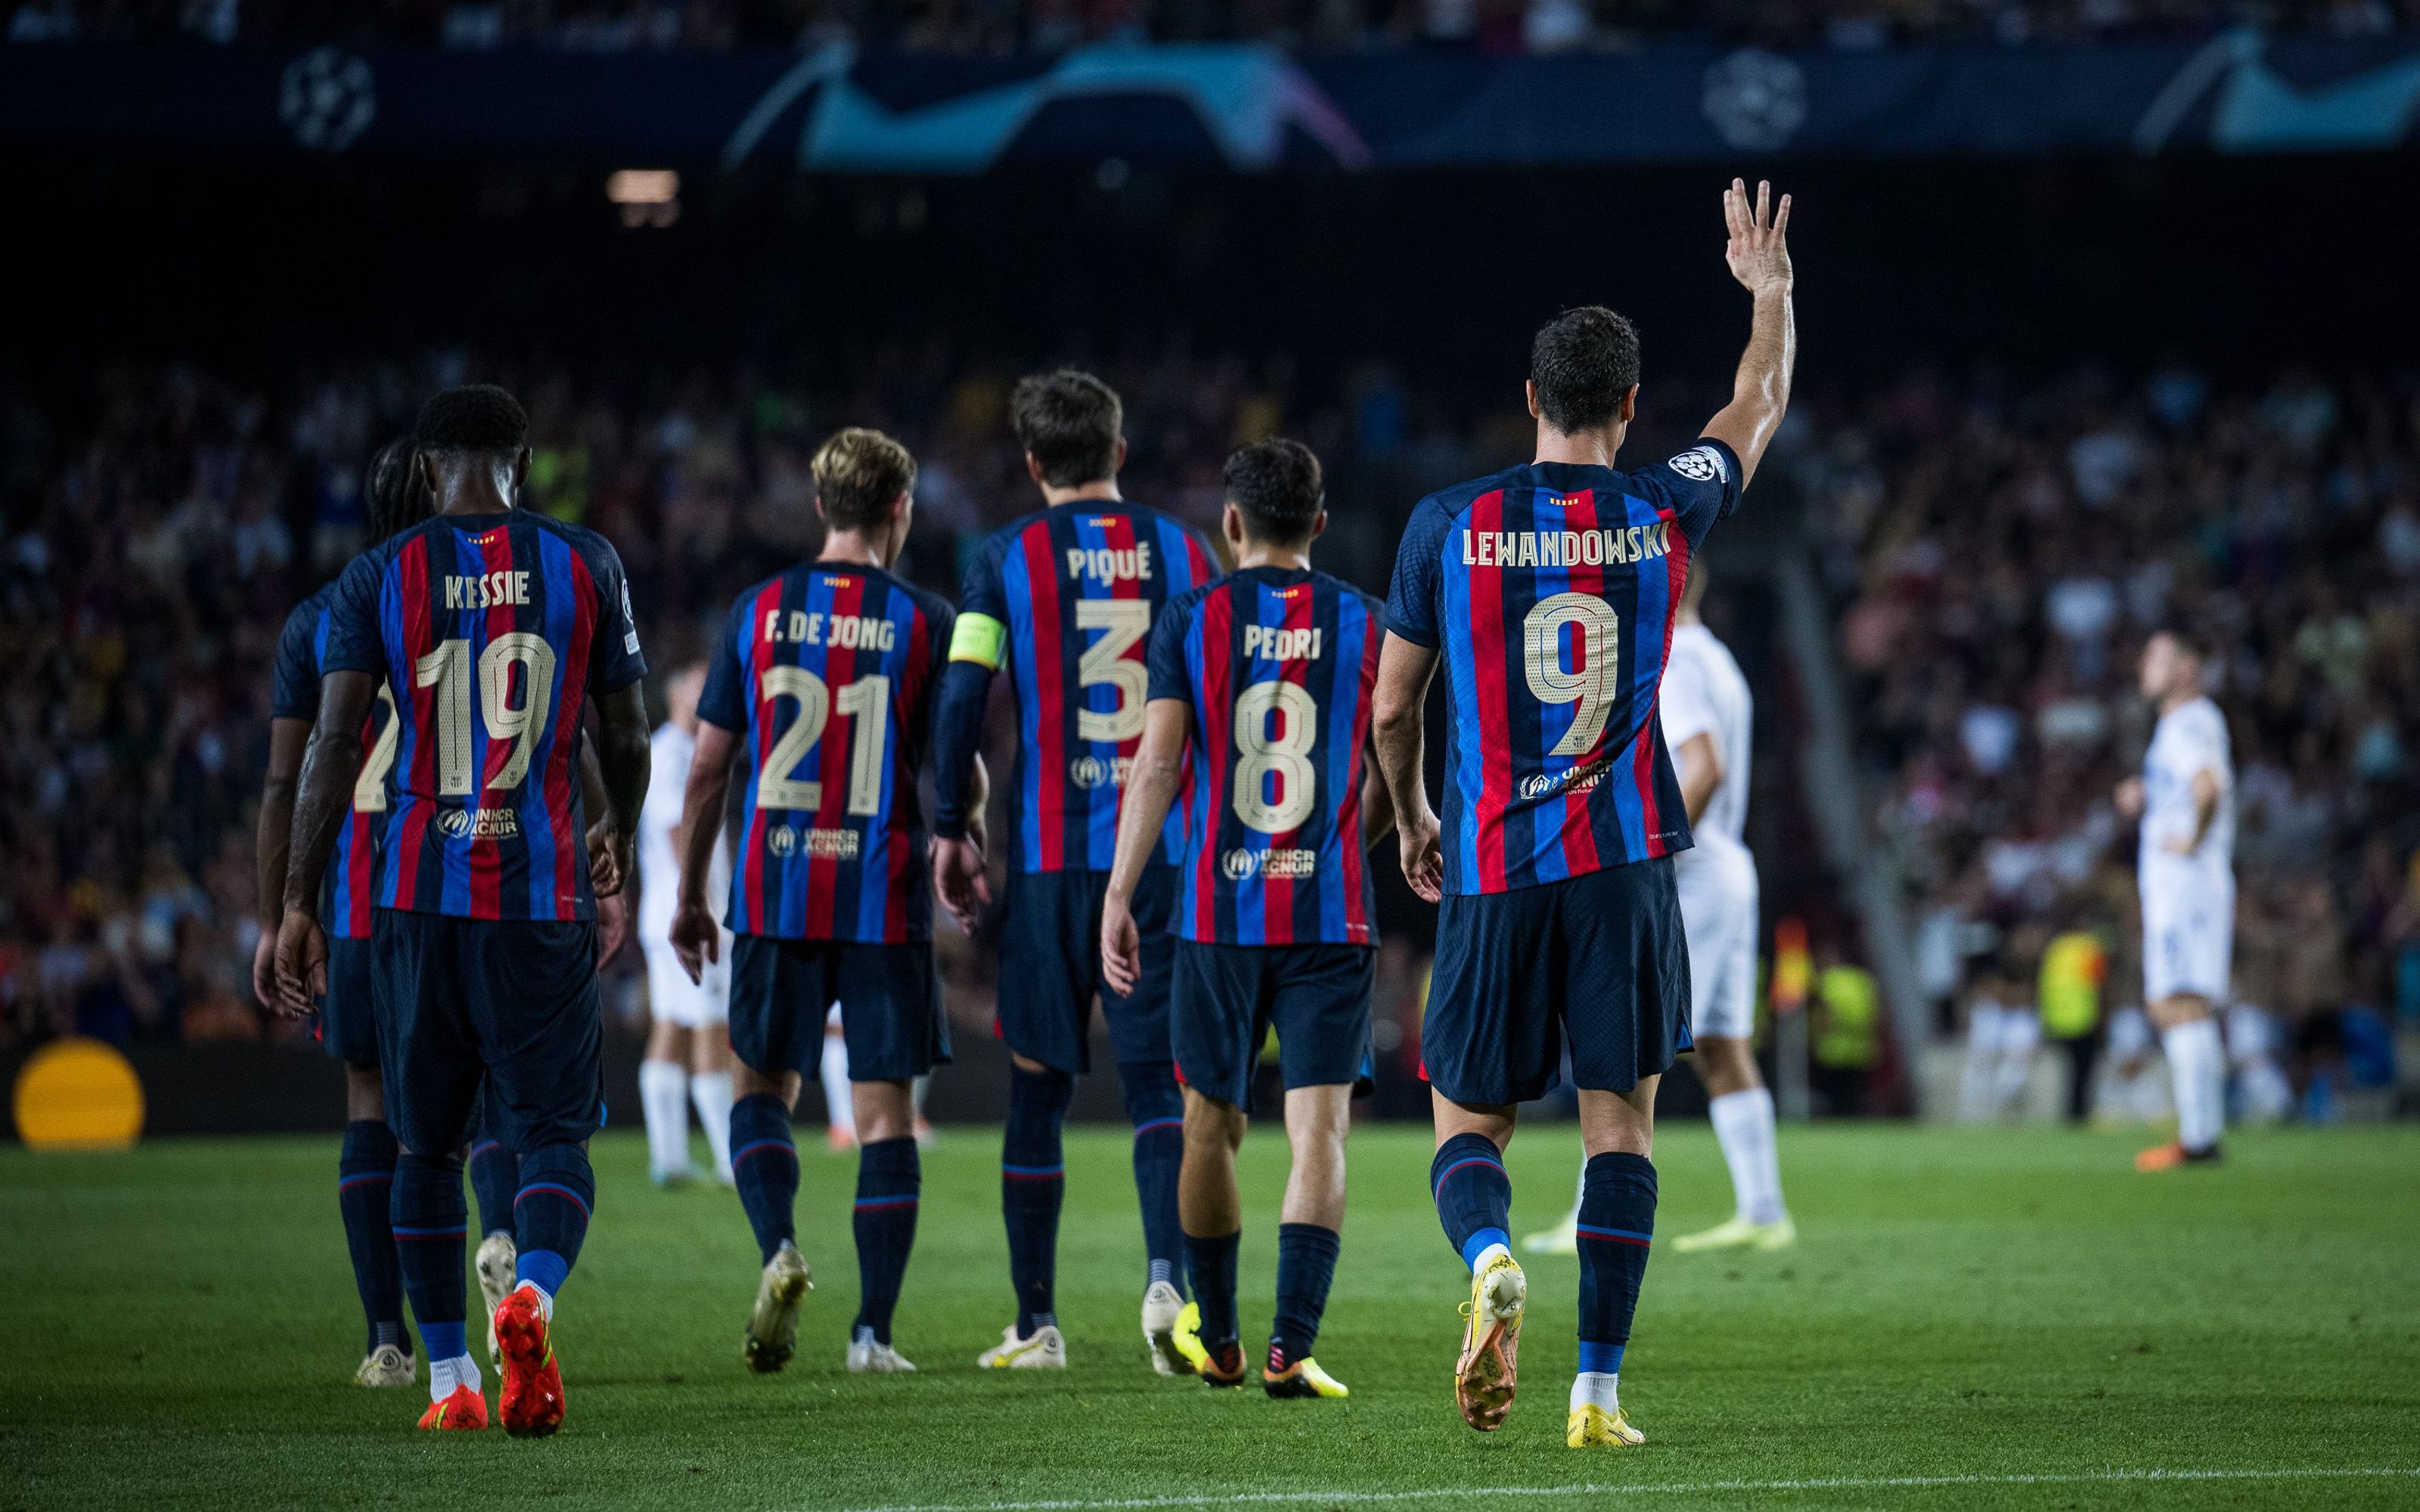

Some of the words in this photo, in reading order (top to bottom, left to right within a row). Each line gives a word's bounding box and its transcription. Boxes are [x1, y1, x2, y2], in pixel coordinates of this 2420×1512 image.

[445, 570, 530, 609] KESSIE
[1067, 541, 1153, 587] PIQUÉ
[1463, 522, 1671, 566] LEWANDOWSKI
[765, 609, 784, 643] F.
[788, 609, 824, 646] DE
[827, 614, 895, 652] JONG
[1075, 600, 1151, 742] 3
[1243, 624, 1322, 662] PEDRI
[1523, 592, 1618, 755] 9
[416, 632, 557, 795] 19
[758, 665, 890, 816] 21
[1233, 680, 1317, 833] 8
